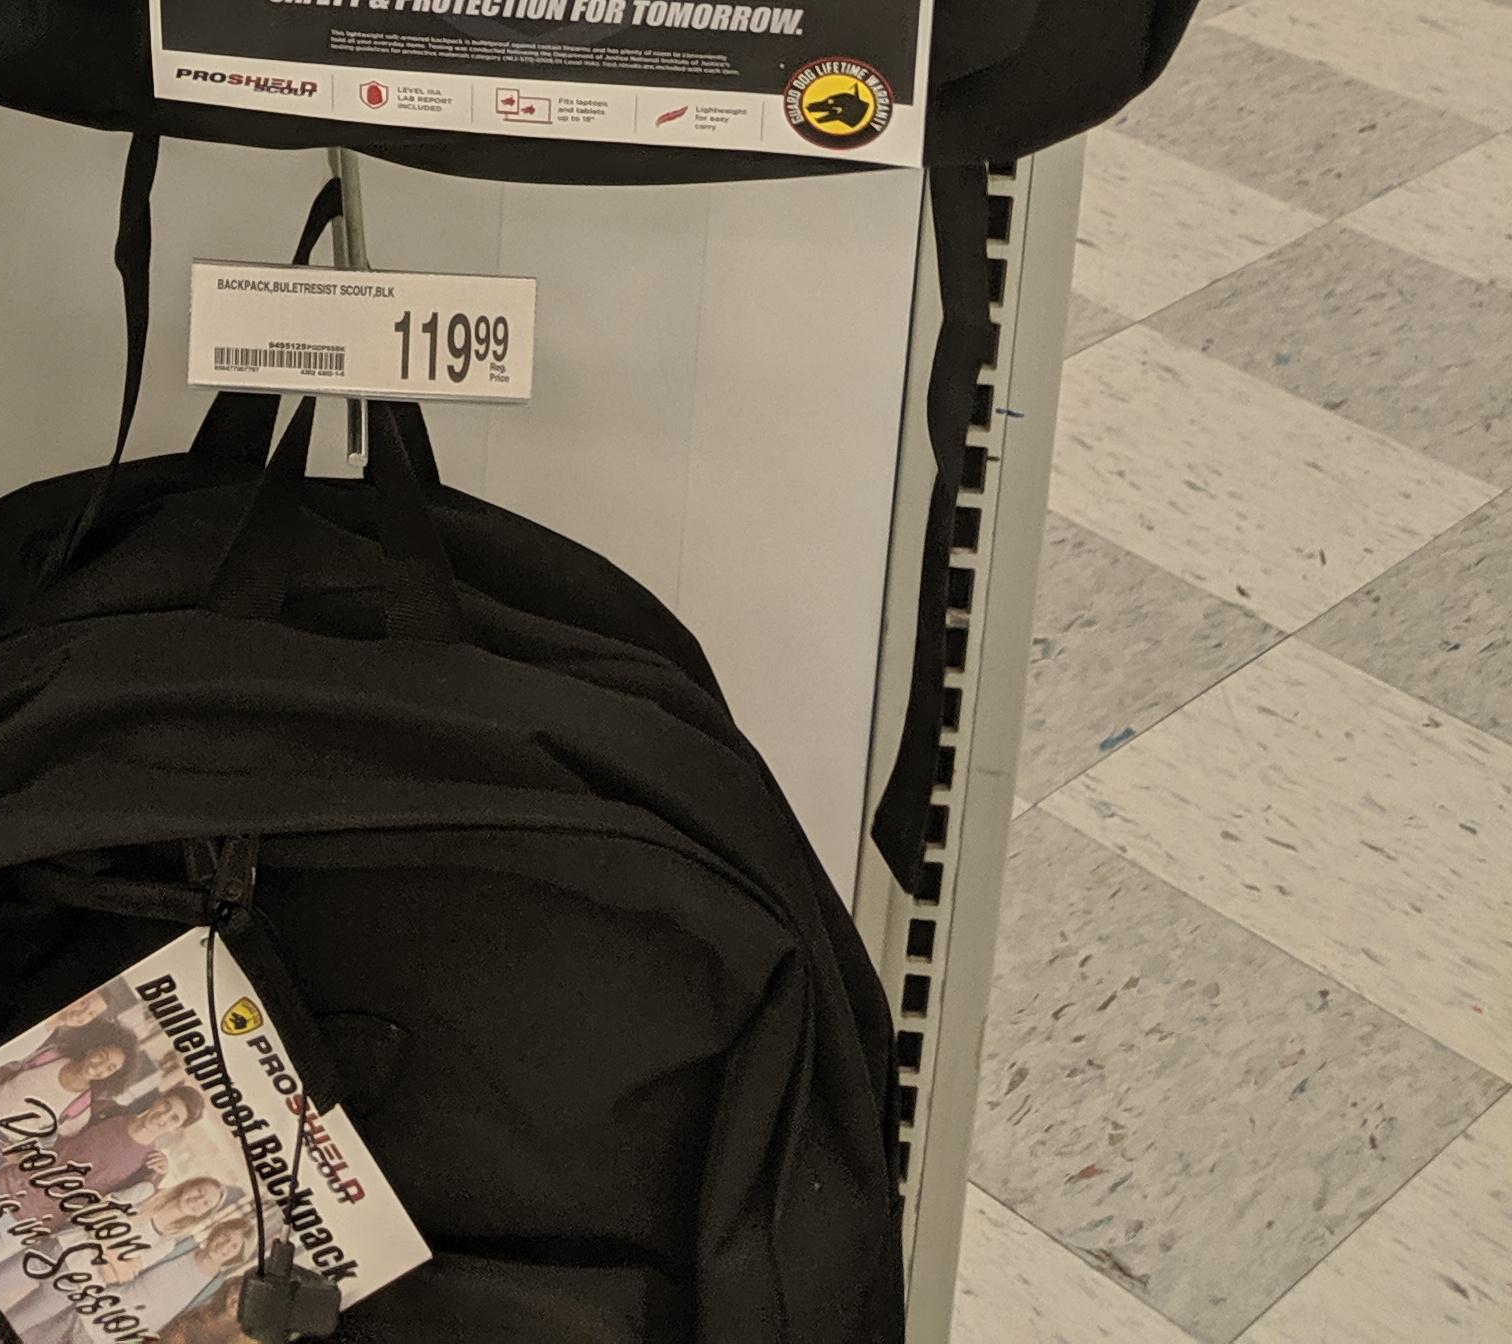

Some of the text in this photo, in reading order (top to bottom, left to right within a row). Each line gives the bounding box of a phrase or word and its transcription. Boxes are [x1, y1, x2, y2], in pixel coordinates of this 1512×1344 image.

[630, 0, 805, 36] TOMORROW.
[176, 68, 318, 92] PROSHIELD
[397, 87, 425, 95] LEVEL
[397, 94, 452, 105] LAB REPORT
[397, 103, 442, 112] INCLUDED
[787, 62, 889, 132] GUARD DOG LIFETIME WARRANTY
[135, 974, 271, 1138] Bulletproof
[8, 1214, 54, 1246] in
